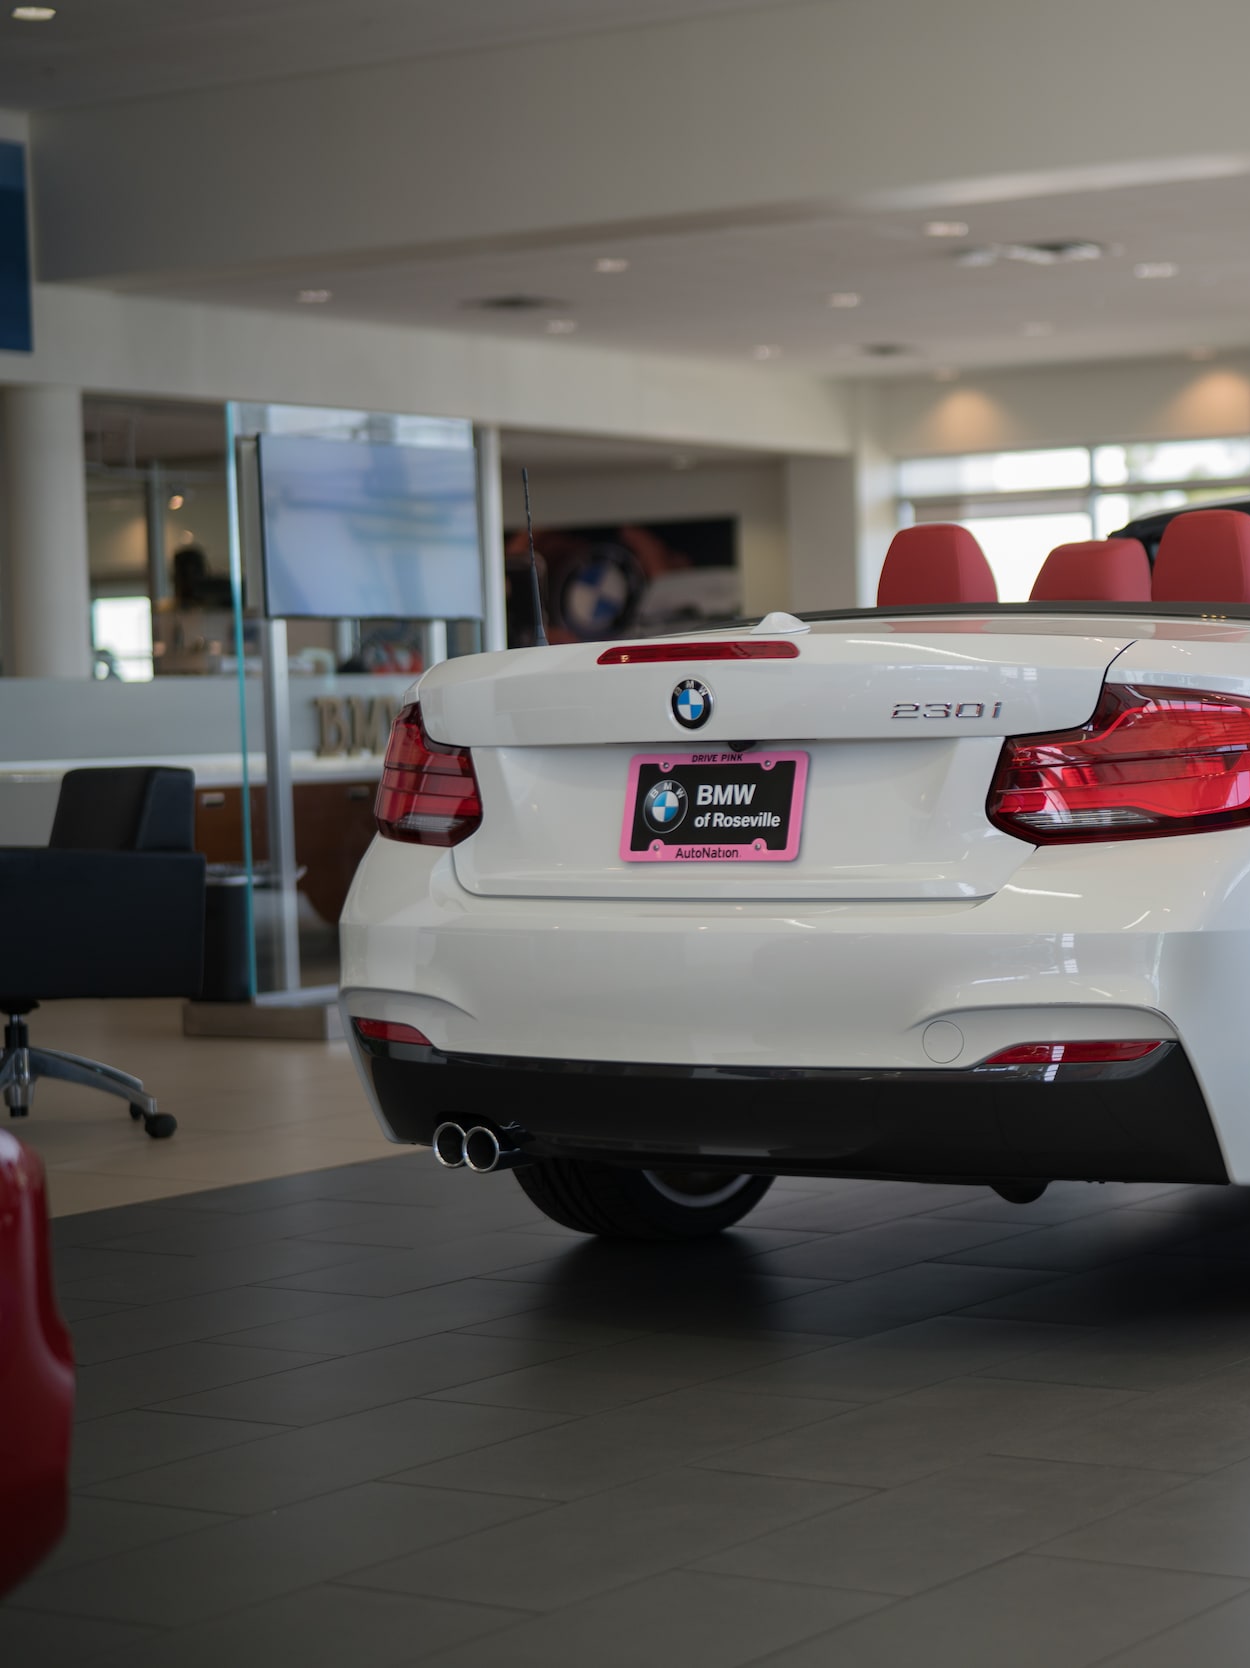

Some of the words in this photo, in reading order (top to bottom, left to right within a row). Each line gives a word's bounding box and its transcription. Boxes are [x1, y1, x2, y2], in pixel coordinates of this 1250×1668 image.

[891, 702, 1002, 719] 230i
[312, 696, 402, 757] BM
[692, 754, 718, 763] DRIVE
[721, 753, 743, 762] PINK
[650, 782, 686, 799] BMW
[697, 784, 756, 805] BMW
[694, 812, 711, 828] of
[712, 812, 781, 828] Roseville
[675, 847, 739, 859] AutoNation
